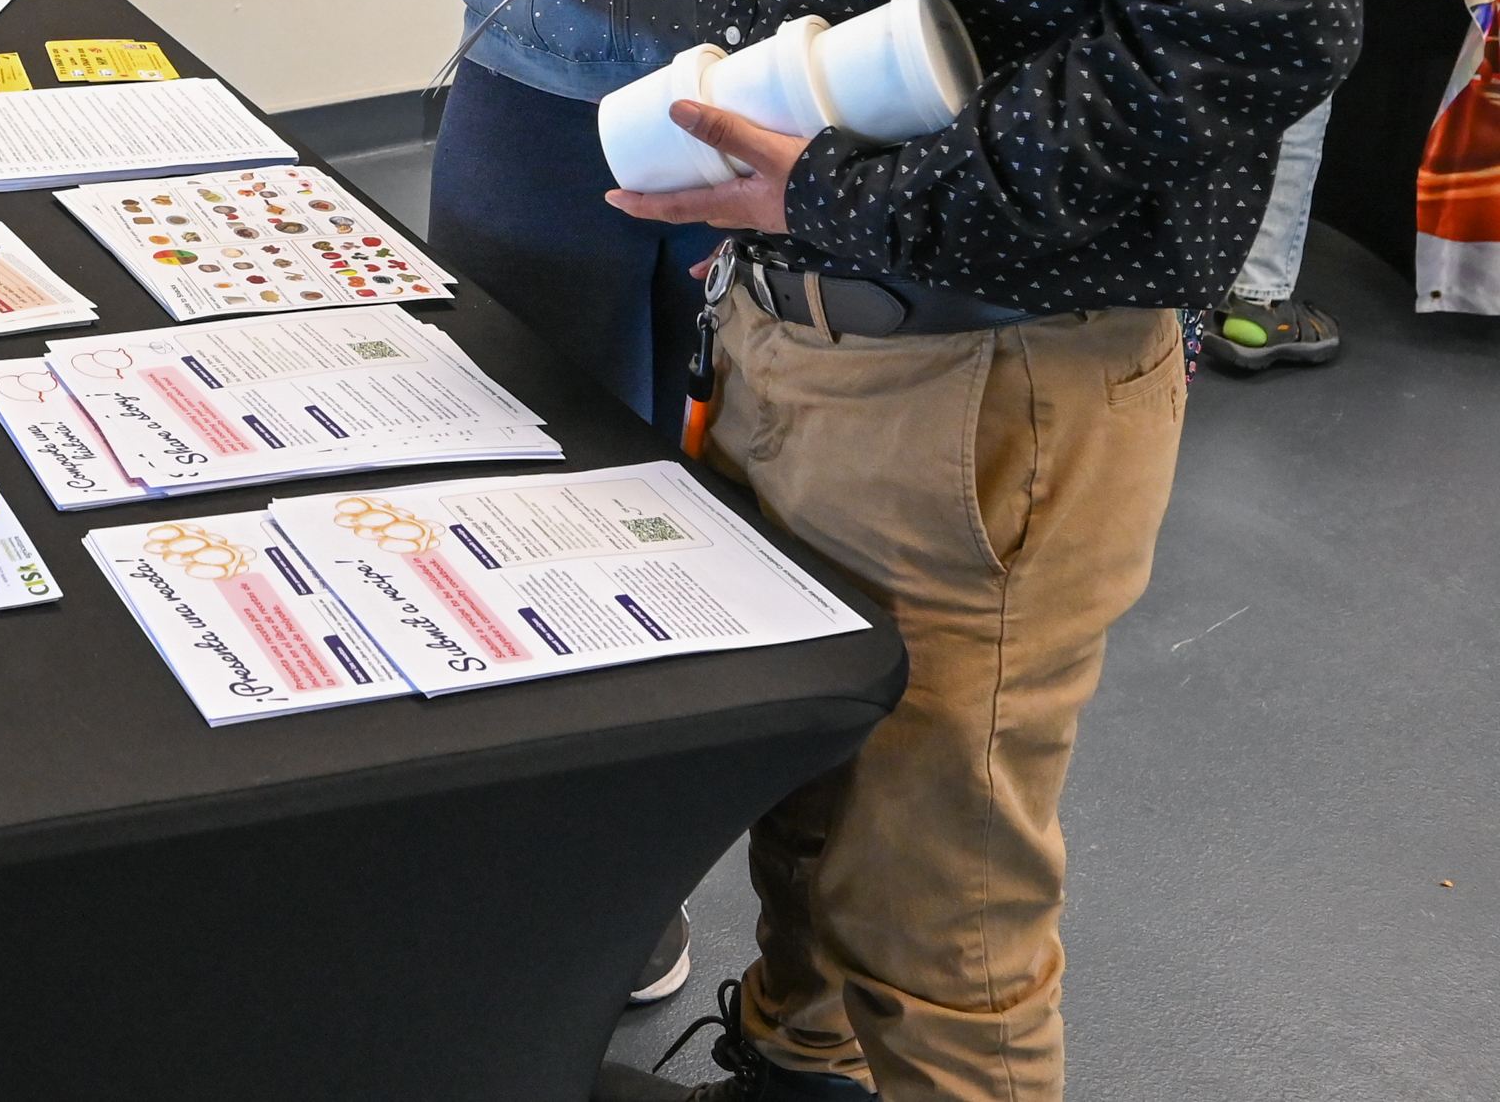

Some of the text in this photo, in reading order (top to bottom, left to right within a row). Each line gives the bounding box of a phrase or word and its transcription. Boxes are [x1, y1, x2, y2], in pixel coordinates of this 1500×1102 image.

[95, 392, 150, 420] story!
[40, 421, 95, 464] historia!
[158, 431, 207, 464] Share
[28, 425, 106, 492] ¡Comparte una
[335, 560, 405, 601] recipe!
[418, 564, 444, 589] included
[245, 592, 268, 614] recetas
[398, 603, 420, 612] a
[430, 559, 518, 656] Holyoke's community cookbook.
[116, 558, 287, 701] ¡Presenta una receta!
[271, 605, 297, 631] Holyoke.
[455, 608, 479, 627] recipe
[269, 625, 288, 640] libro
[401, 616, 486, 671] Submit
[480, 635, 505, 657] Submit
[244, 608, 305, 689] Presenta una receta para
[287, 650, 301, 658] en
